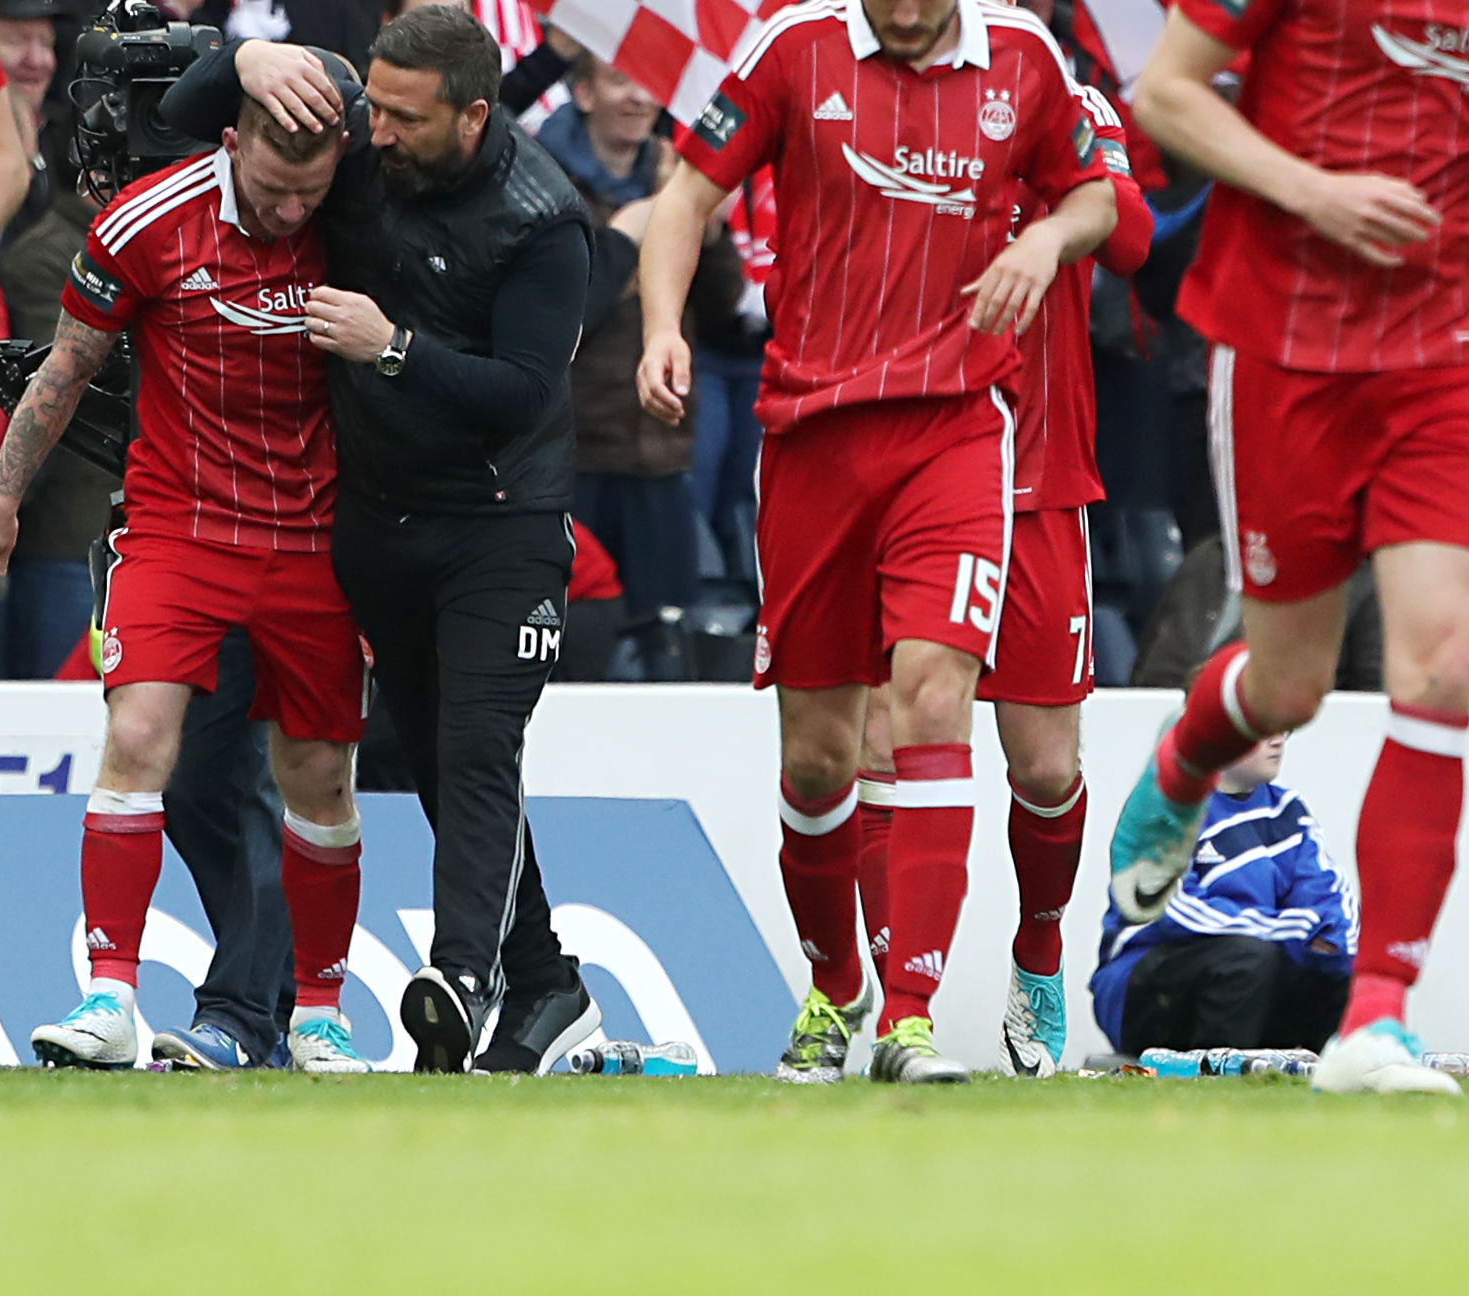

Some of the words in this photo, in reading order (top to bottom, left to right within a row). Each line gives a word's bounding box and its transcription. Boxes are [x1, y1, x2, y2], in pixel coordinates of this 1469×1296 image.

[813, 109, 853, 121] adidas
[893, 145, 985, 181] Saltire
[936, 203, 975, 219] energy
[181, 281, 220, 291] adidas
[949, 552, 1001, 634] 15
[527, 616, 561, 626] adidas
[517, 625, 561, 662] DM
[1069, 614, 1087, 685] 7
